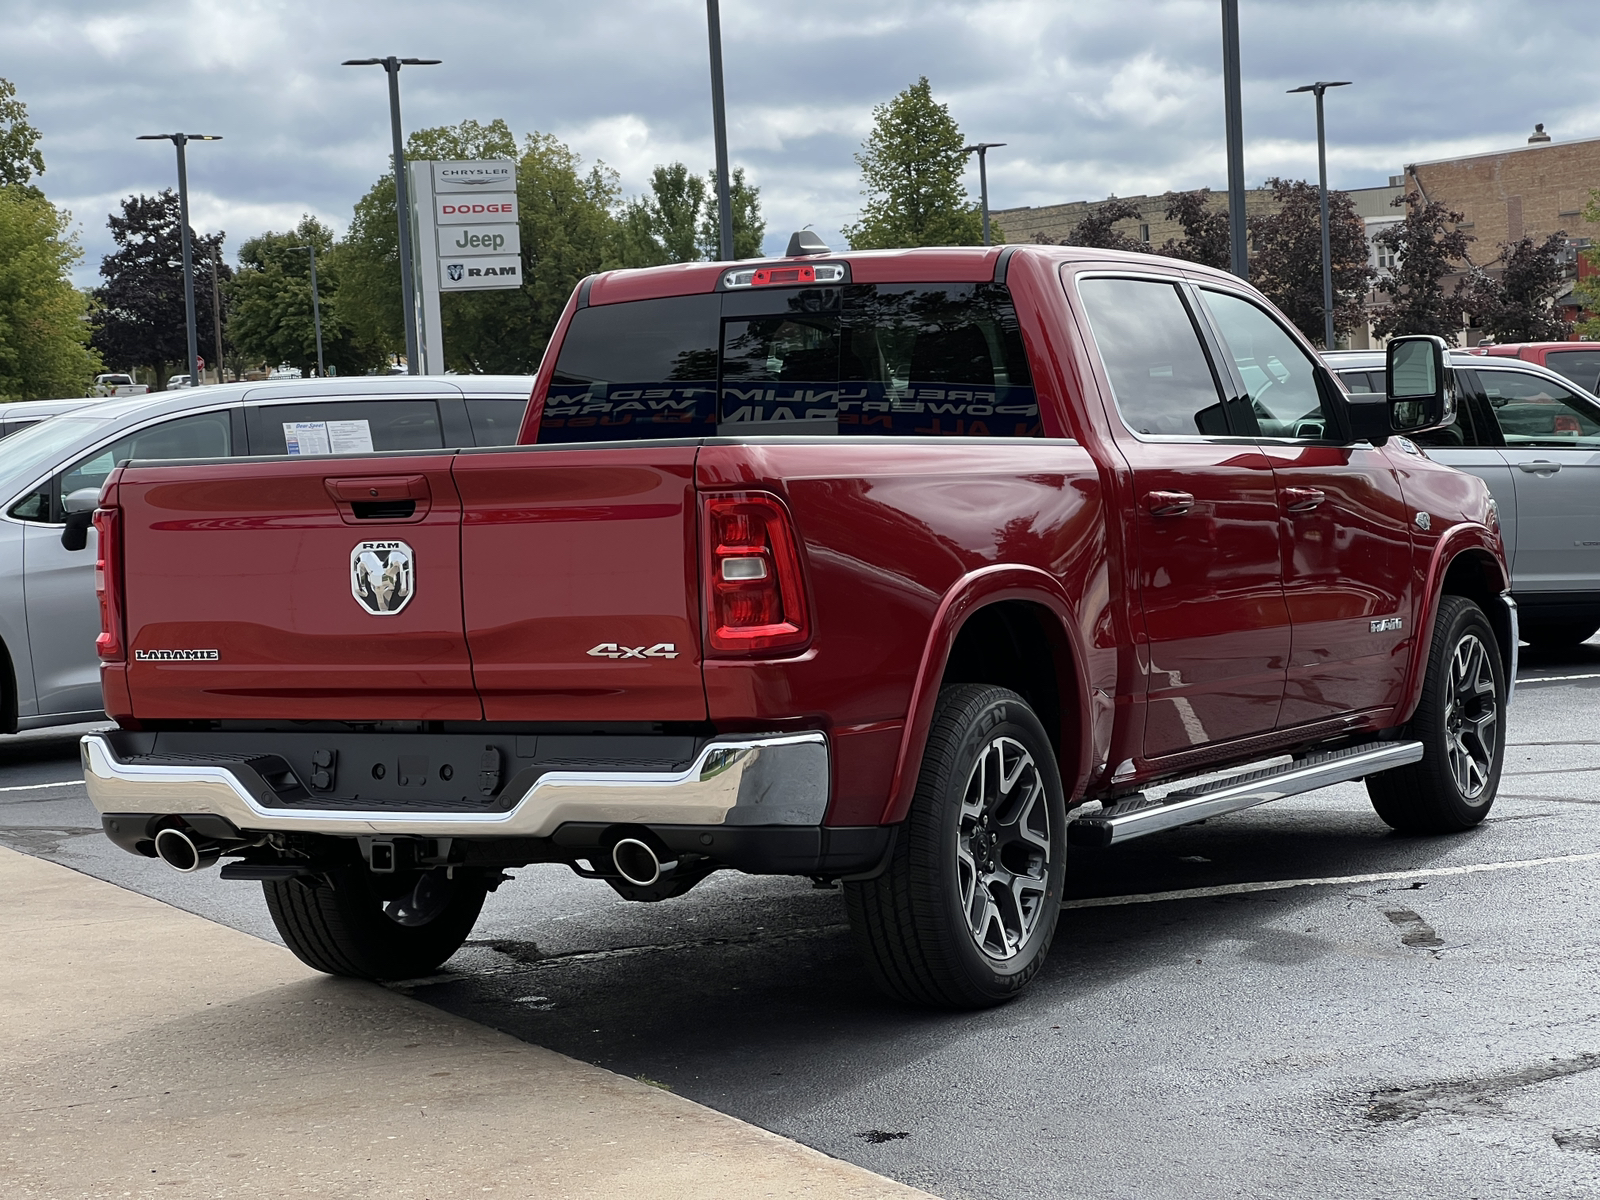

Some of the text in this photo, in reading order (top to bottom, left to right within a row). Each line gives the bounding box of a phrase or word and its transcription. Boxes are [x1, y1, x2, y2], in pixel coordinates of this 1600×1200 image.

[442, 168, 509, 176] CHRYSLER
[442, 203, 513, 215] DODGE
[455, 230, 505, 251] Jeep
[468, 266, 517, 277] RAM
[135, 649, 219, 661] LARAMIE
[586, 643, 680, 659] 4x4
